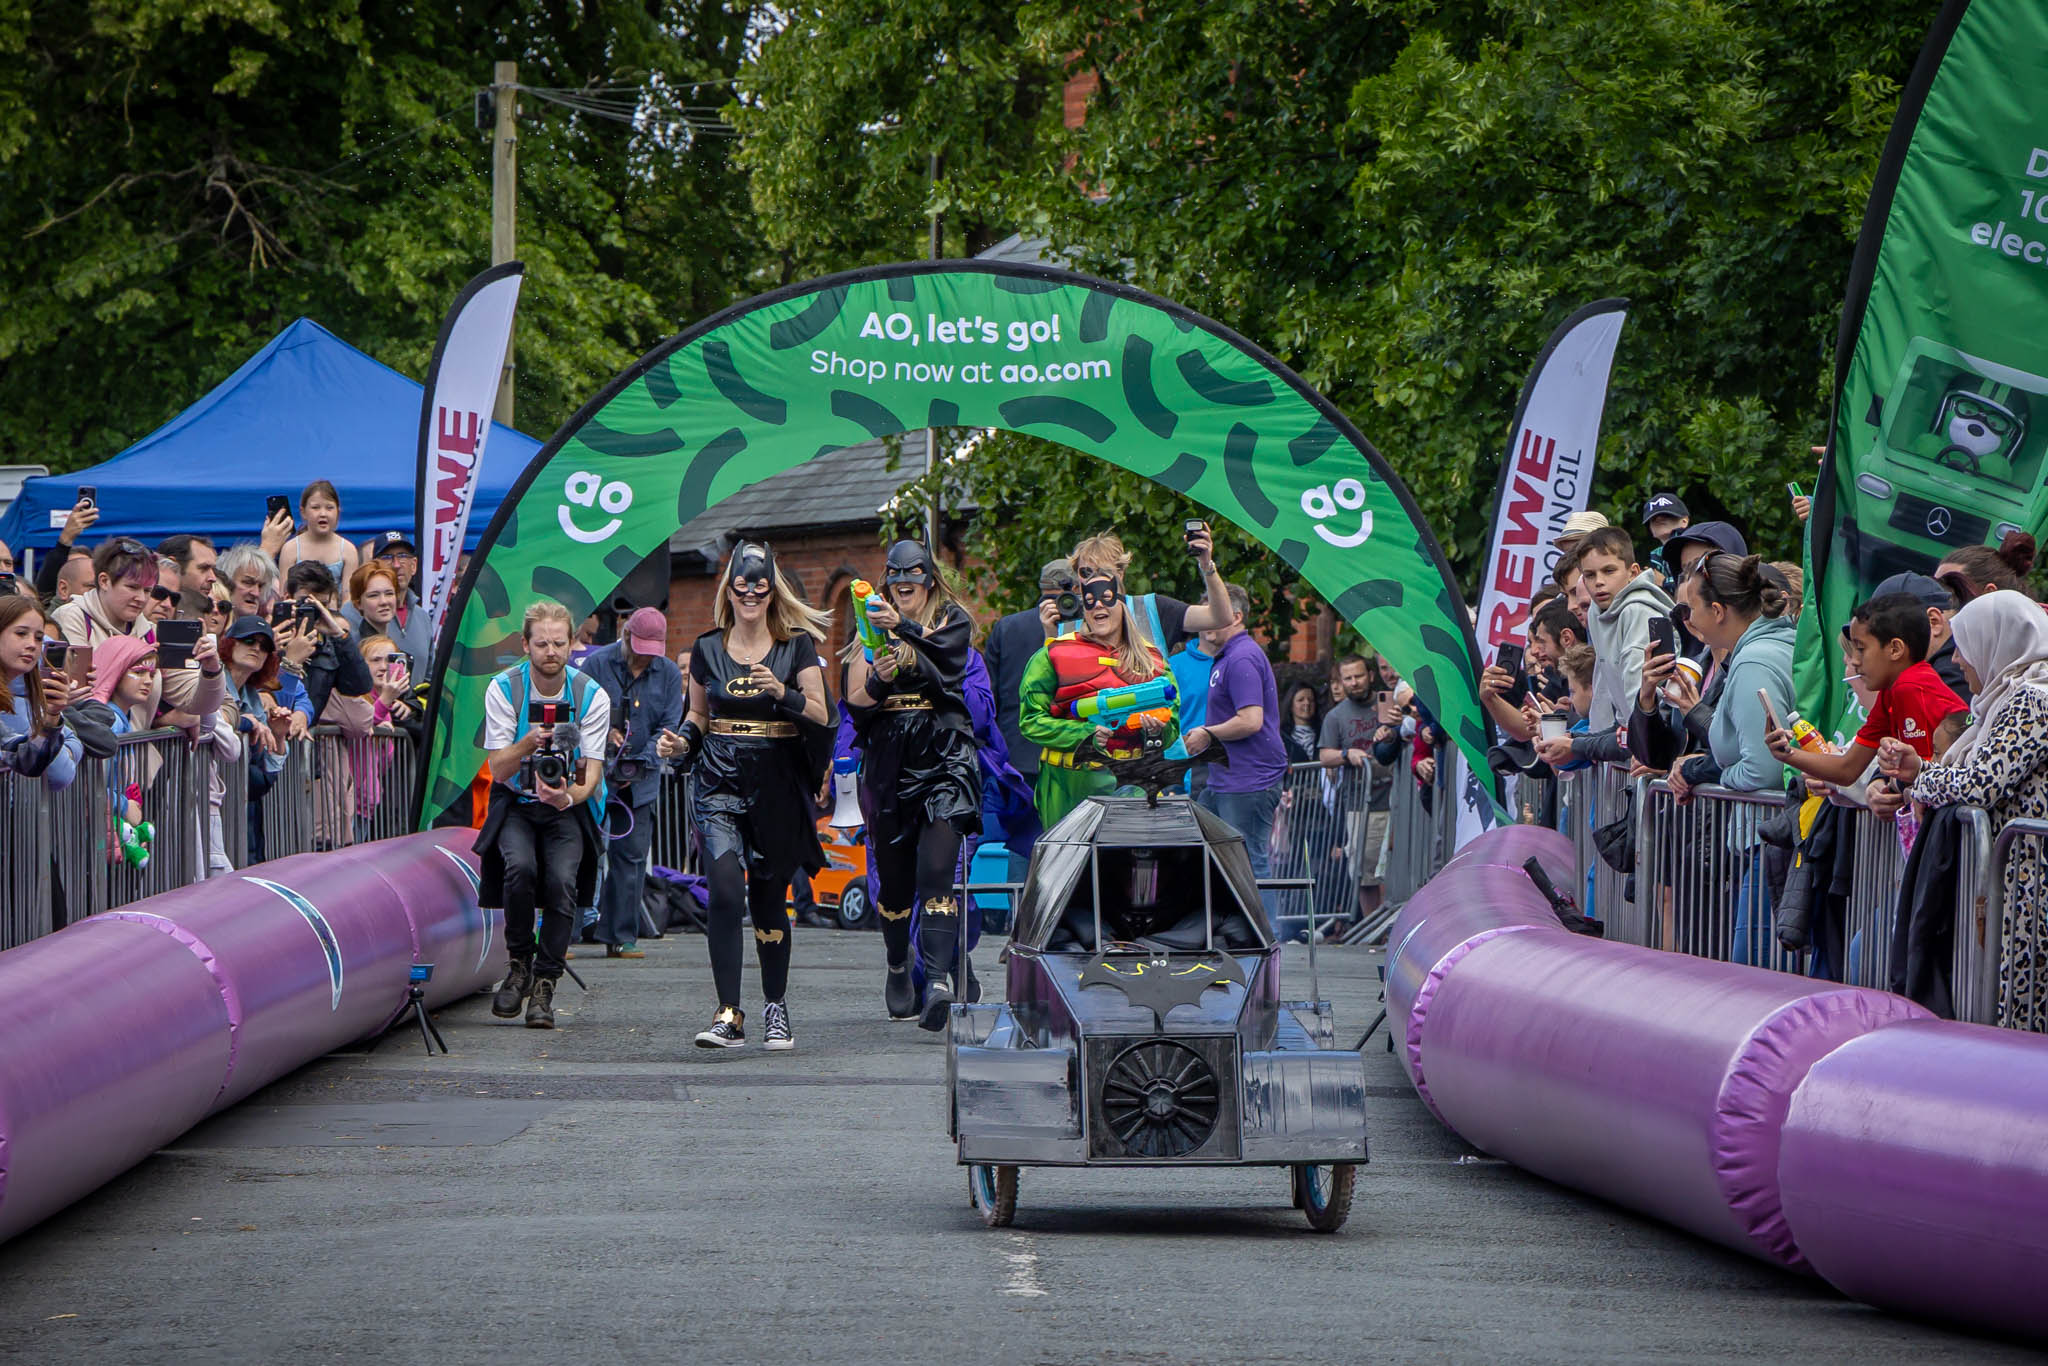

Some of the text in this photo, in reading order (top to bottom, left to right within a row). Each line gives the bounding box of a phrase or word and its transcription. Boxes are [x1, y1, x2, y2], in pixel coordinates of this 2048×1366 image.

[1971, 220, 2048, 265] elec
[859, 311, 1061, 352] AO, let's go!
[809, 350, 1112, 384] Shop now at ao.com
[564, 471, 633, 514] ao
[1300, 478, 1366, 519] ao
[1484, 428, 1556, 669] REWE
